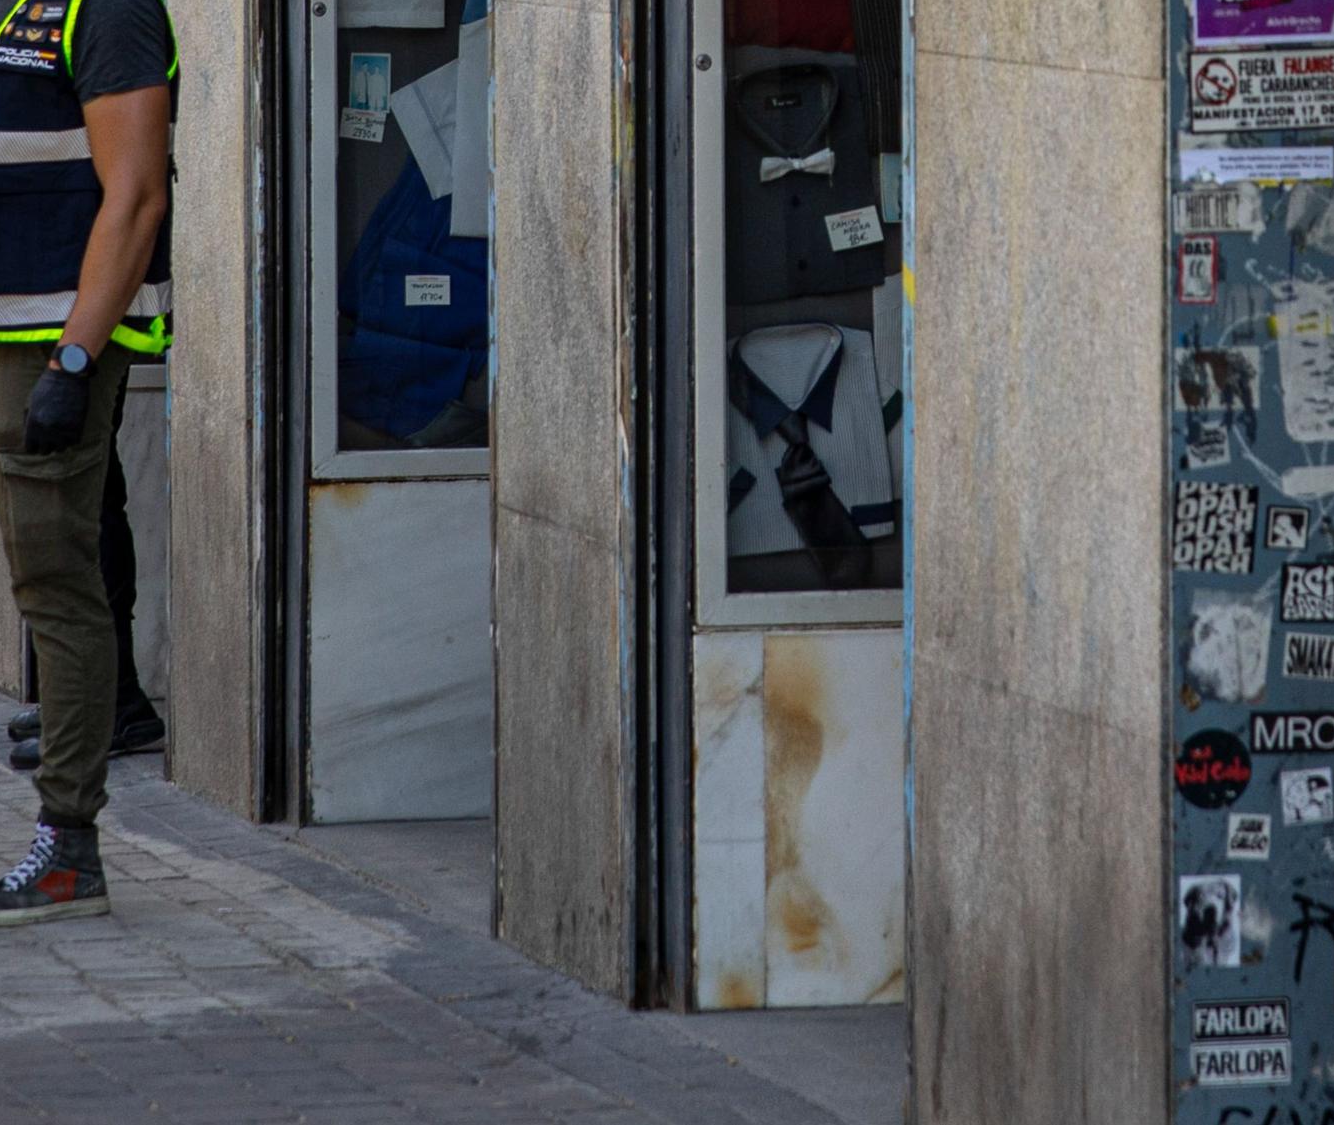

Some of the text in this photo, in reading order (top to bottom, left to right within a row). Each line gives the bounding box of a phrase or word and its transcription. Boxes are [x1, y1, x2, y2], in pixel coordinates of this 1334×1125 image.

[1239, 58, 1276, 76] FUERA
[1240, 78, 1252, 94] DE
[1194, 105, 1295, 120] MANIFESTACION
[1302, 105, 1315, 116] 17
[1185, 242, 1211, 255] DAS
[1176, 488, 1255, 519] OPAL
[1175, 508, 1254, 543] PUSH
[1174, 531, 1252, 563] OPAL
[1195, 1005, 1287, 1036] FARLOPA
[1196, 1049, 1286, 1076] FARLOPA
